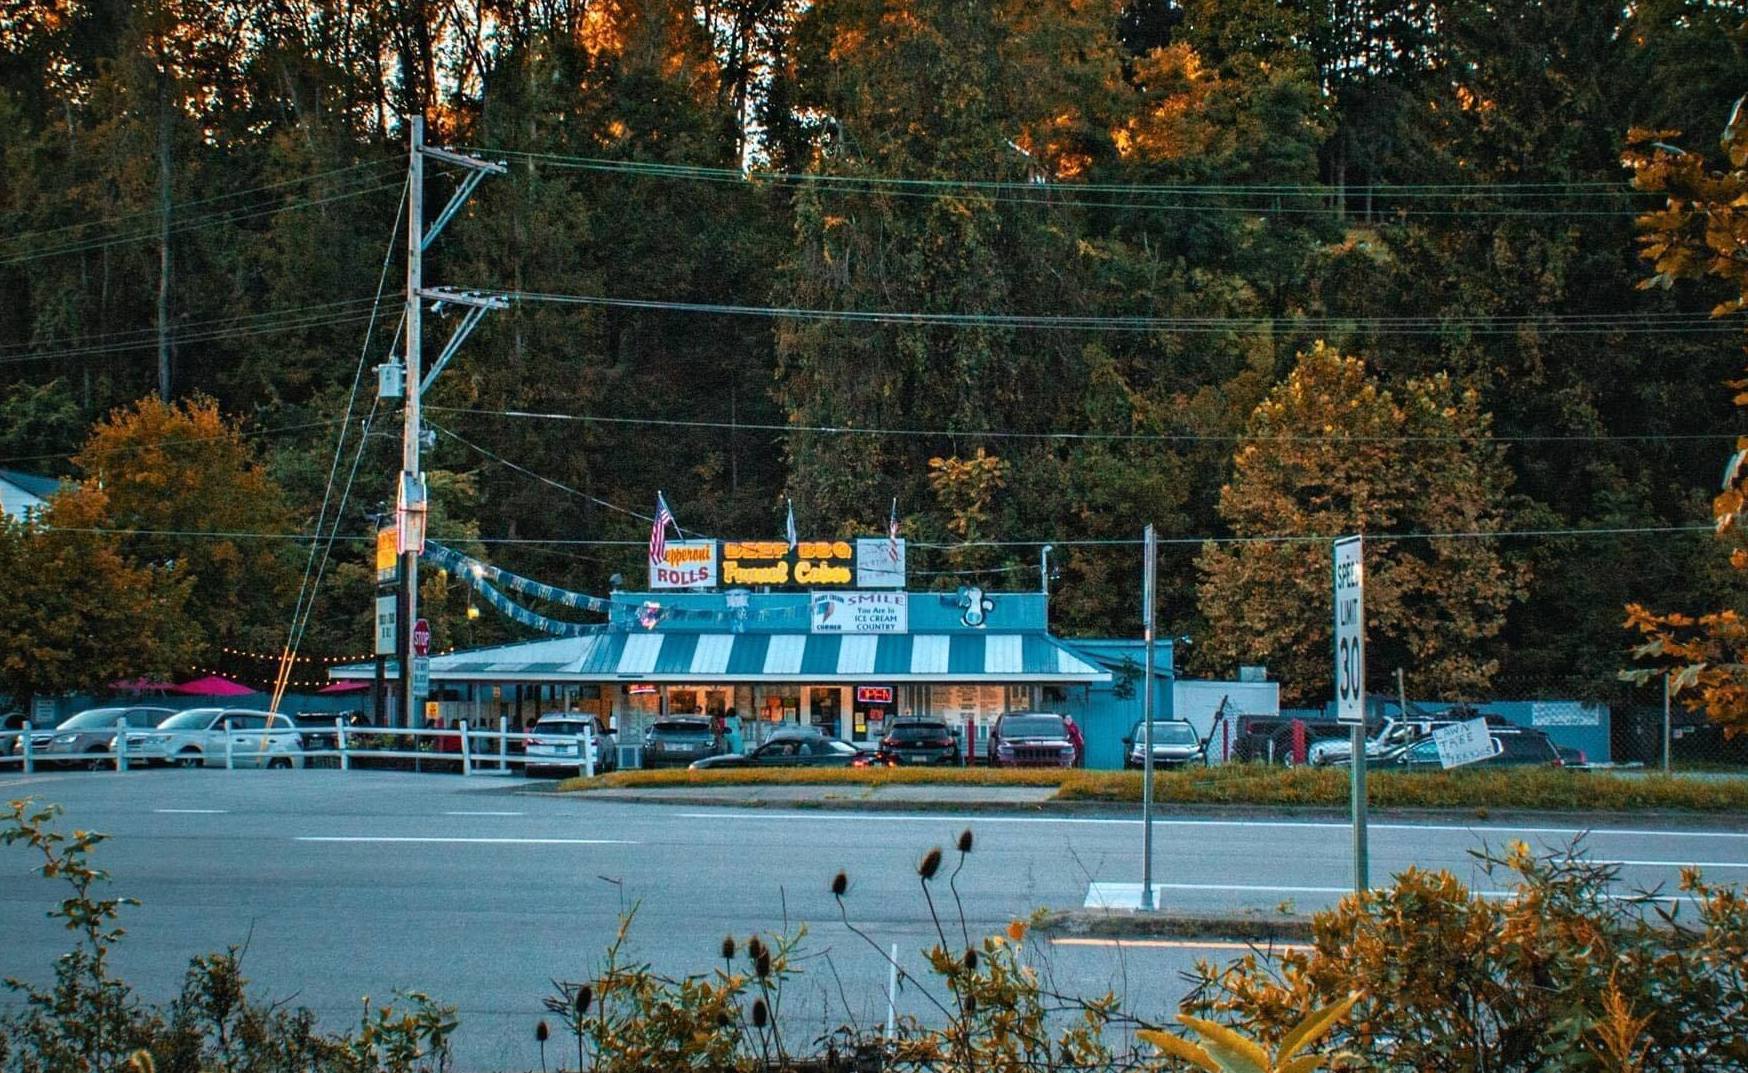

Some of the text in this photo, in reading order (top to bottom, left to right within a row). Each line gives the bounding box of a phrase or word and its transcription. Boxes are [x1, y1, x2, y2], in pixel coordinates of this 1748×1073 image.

[798, 541, 852, 559] BBQ
[657, 566, 709, 585] ROLLS
[847, 594, 904, 606] SMILE
[873, 606, 886, 614] Are
[1340, 599, 1357, 626] LIMIT
[856, 623, 896, 631] COUNTRY
[414, 631, 430, 646] STOP
[1340, 637, 1360, 701] 30
[860, 688, 890, 701] OPEN
